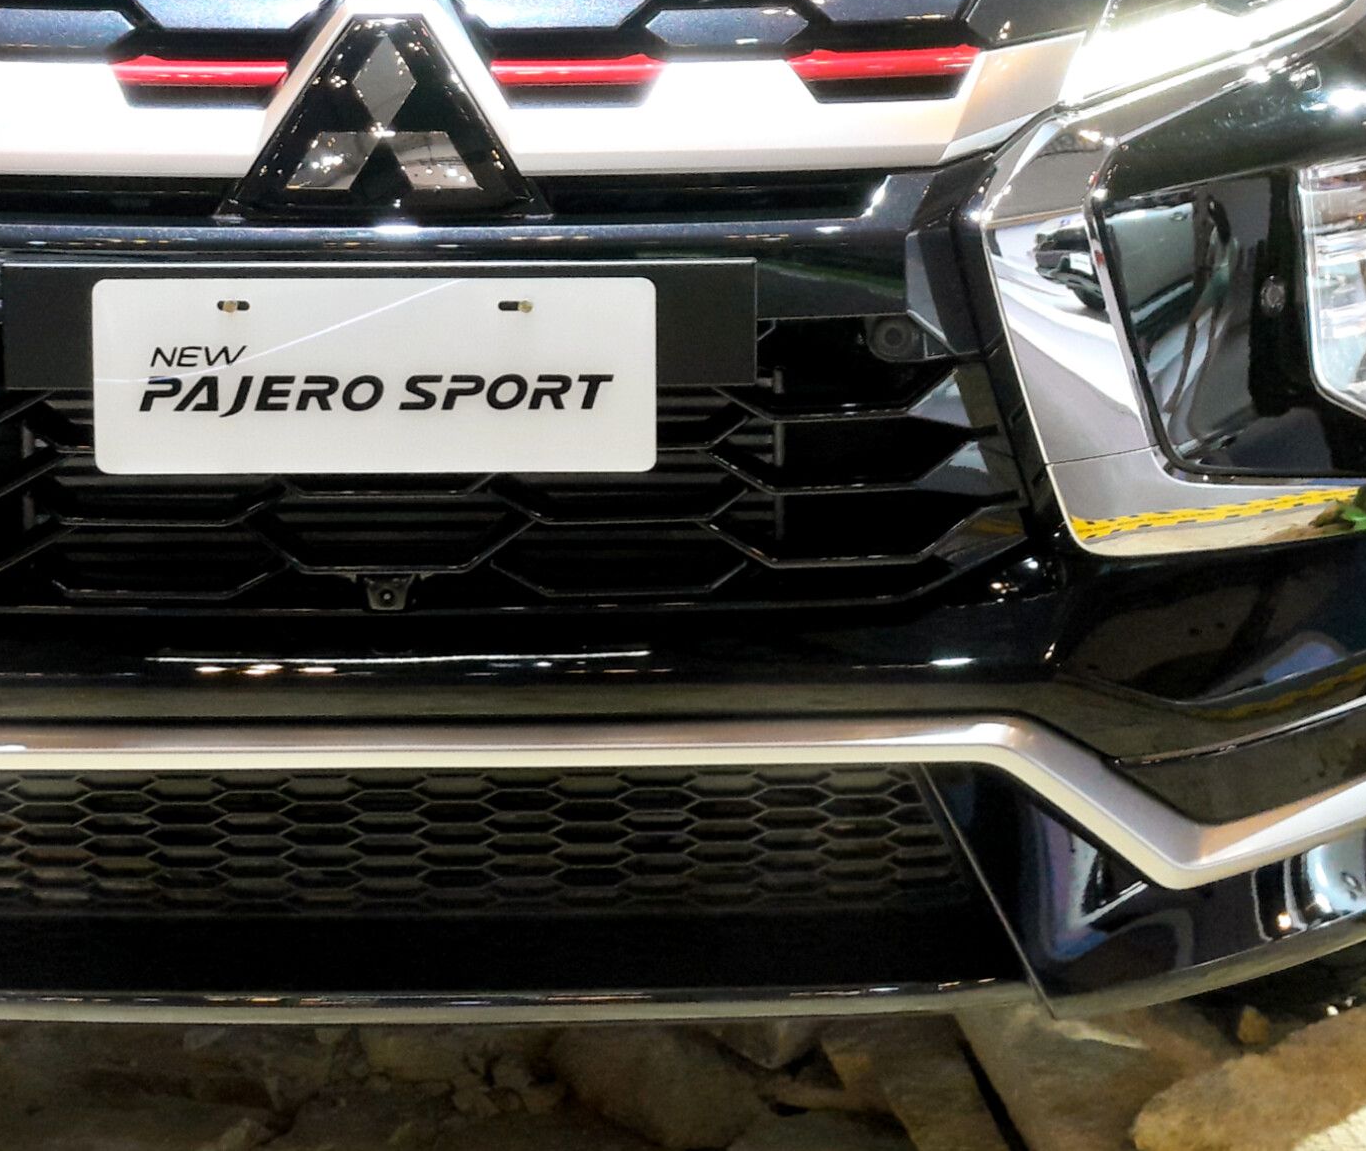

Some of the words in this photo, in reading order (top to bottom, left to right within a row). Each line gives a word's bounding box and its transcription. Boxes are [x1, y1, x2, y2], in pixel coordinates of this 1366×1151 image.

[149, 344, 248, 369] NEW
[138, 374, 385, 418] PAJERO
[397, 373, 615, 411] SPORT
